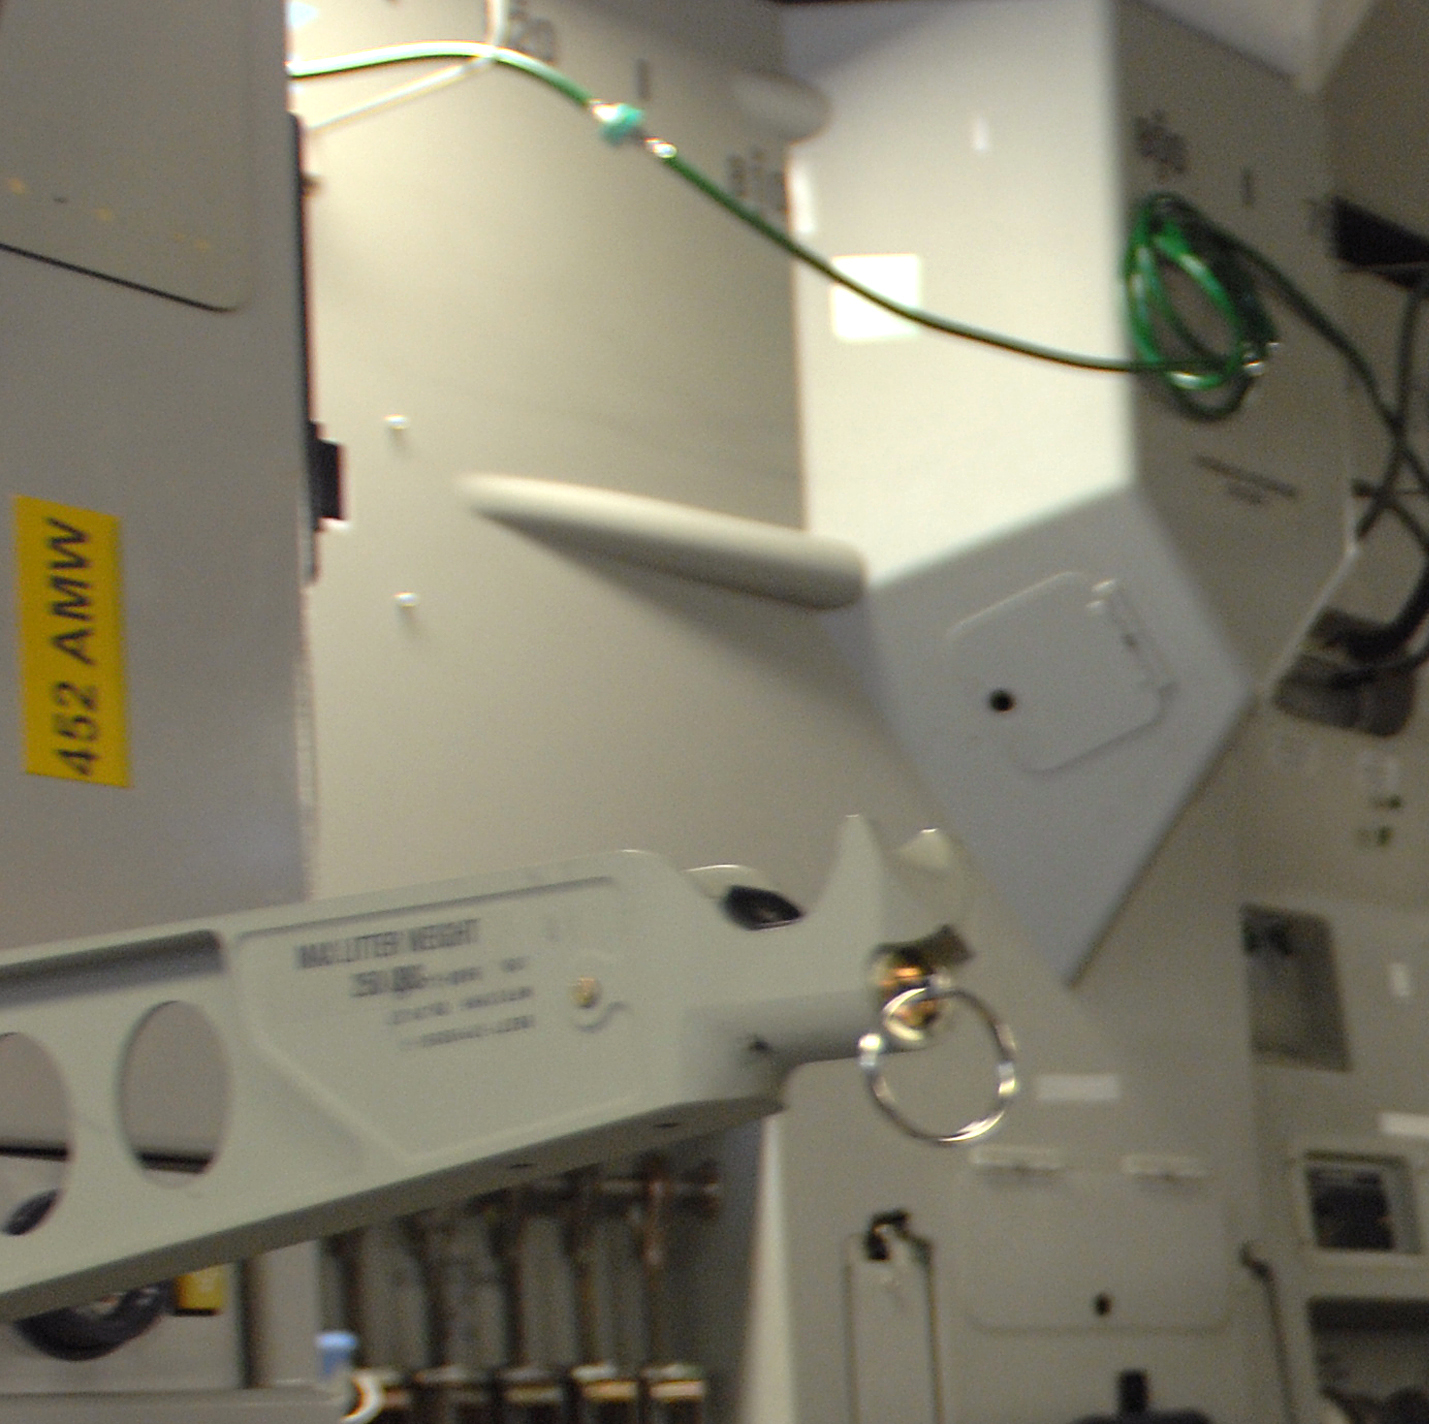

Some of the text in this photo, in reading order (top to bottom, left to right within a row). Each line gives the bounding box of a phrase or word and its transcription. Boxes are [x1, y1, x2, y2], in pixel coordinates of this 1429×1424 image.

[48, 517, 99, 777] 452 AMW
[409, 918, 480, 952] WEIGHT
